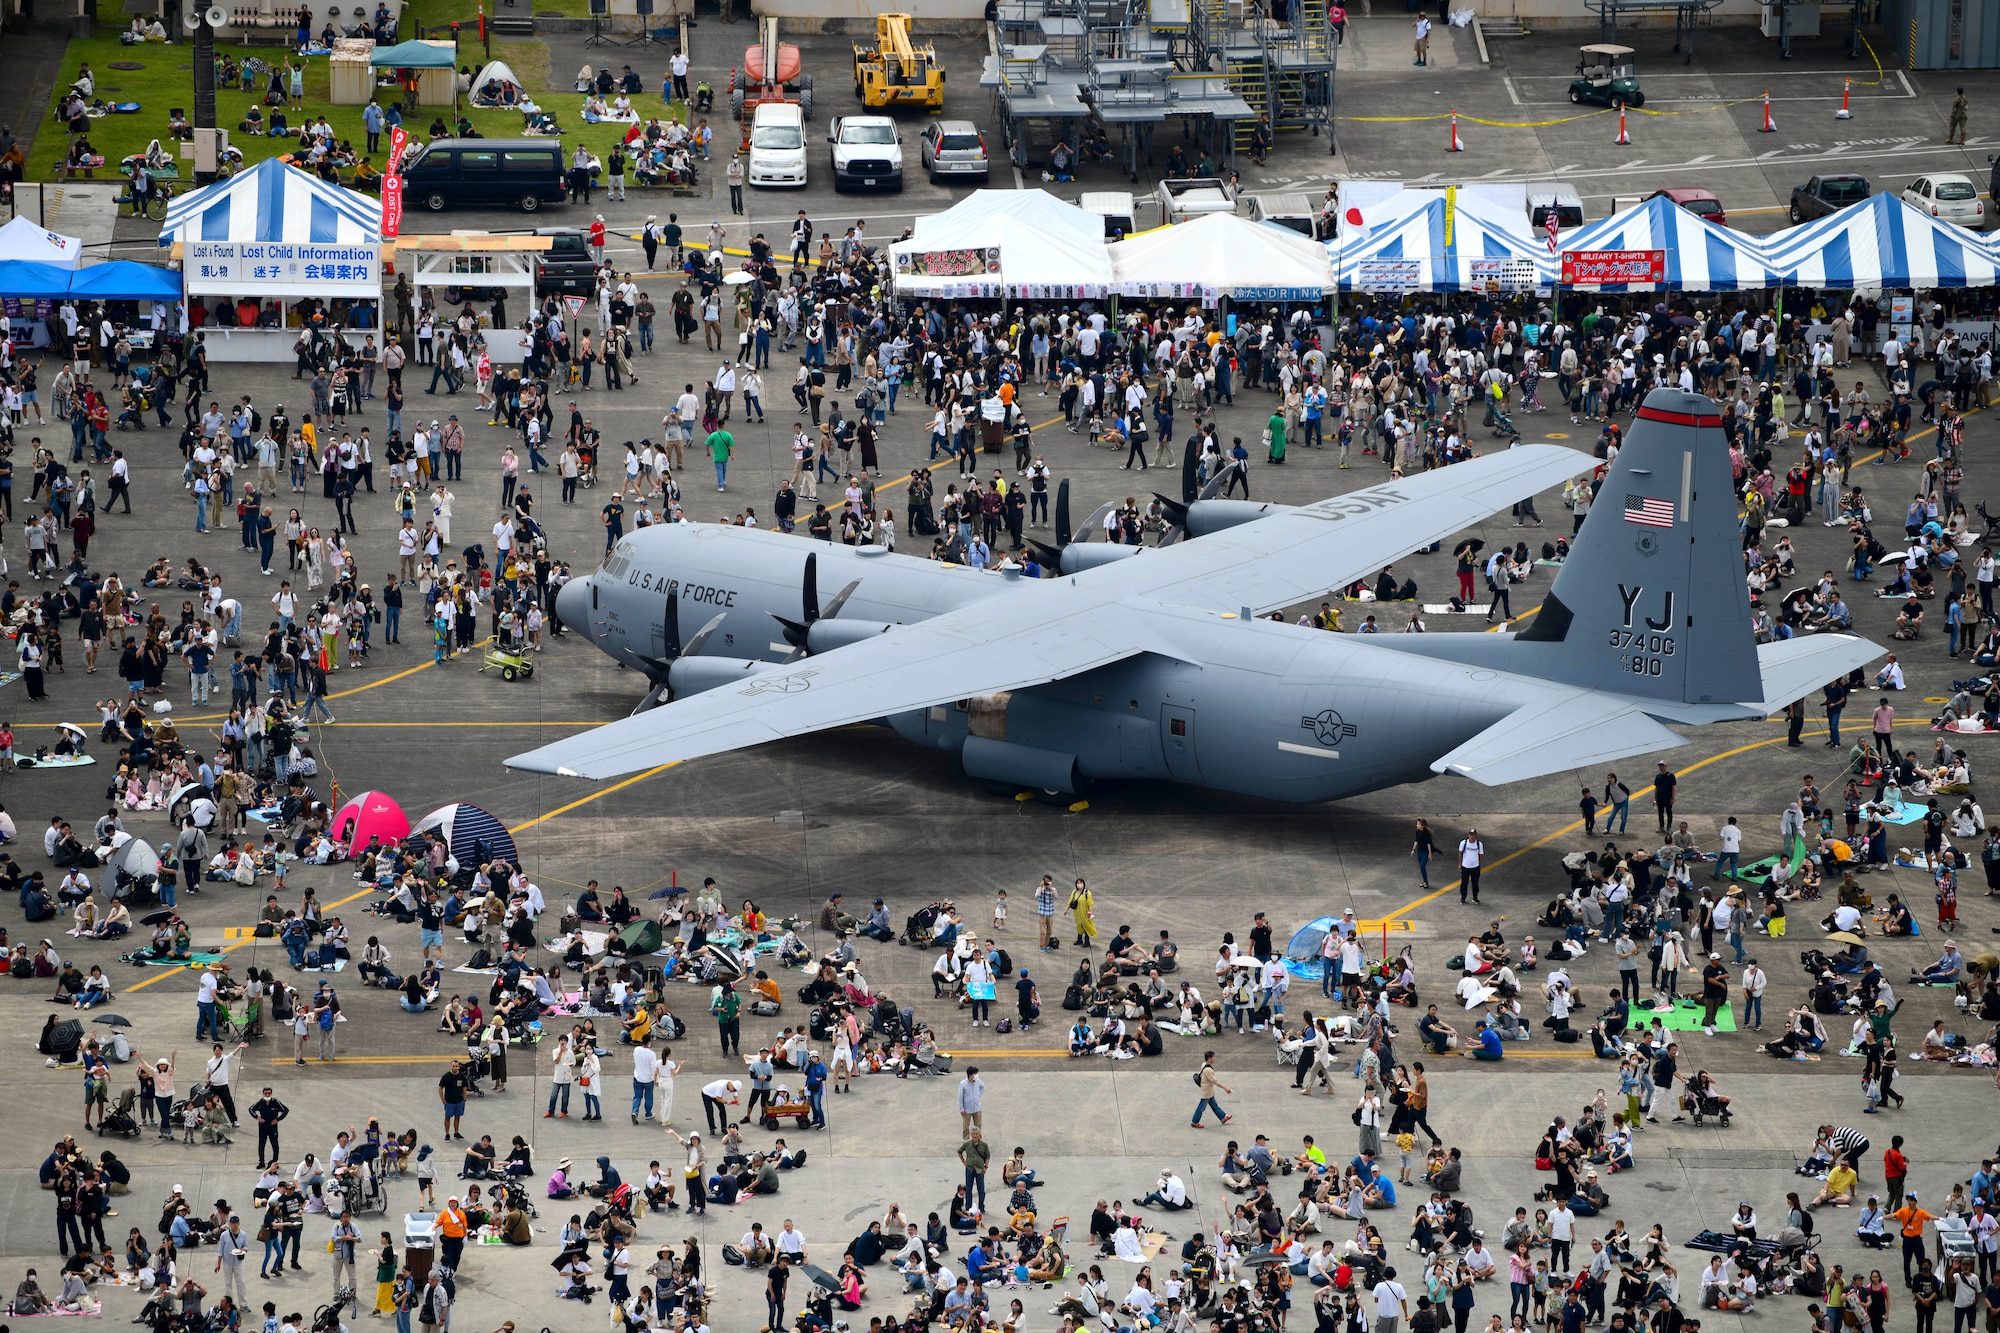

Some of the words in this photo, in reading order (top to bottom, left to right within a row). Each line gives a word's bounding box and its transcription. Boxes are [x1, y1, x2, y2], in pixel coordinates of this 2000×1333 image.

[1787, 142, 1821, 150] NO
[1833, 135, 1930, 147] PARKING
[1306, 170, 1402, 181] PARKING
[388, 192, 396, 211] LOST
[193, 244, 208, 258] Lost
[214, 244, 234, 258] Found
[241, 244, 265, 259] Lost
[268, 245, 293, 259] Child
[298, 246, 374, 261] Information
[1580, 252, 1613, 261] MILITARY
[1614, 252, 1646, 260] T-SHIRTS
[201, 265, 228, 278] 落し物
[253, 265, 281, 278] 迷子
[304, 264, 368, 280] 会場案内
[1289, 485, 1411, 521] USAF
[654, 577, 679, 595] AIR
[682, 583, 738, 608] FORCE
[1632, 655, 1663, 678] 810
